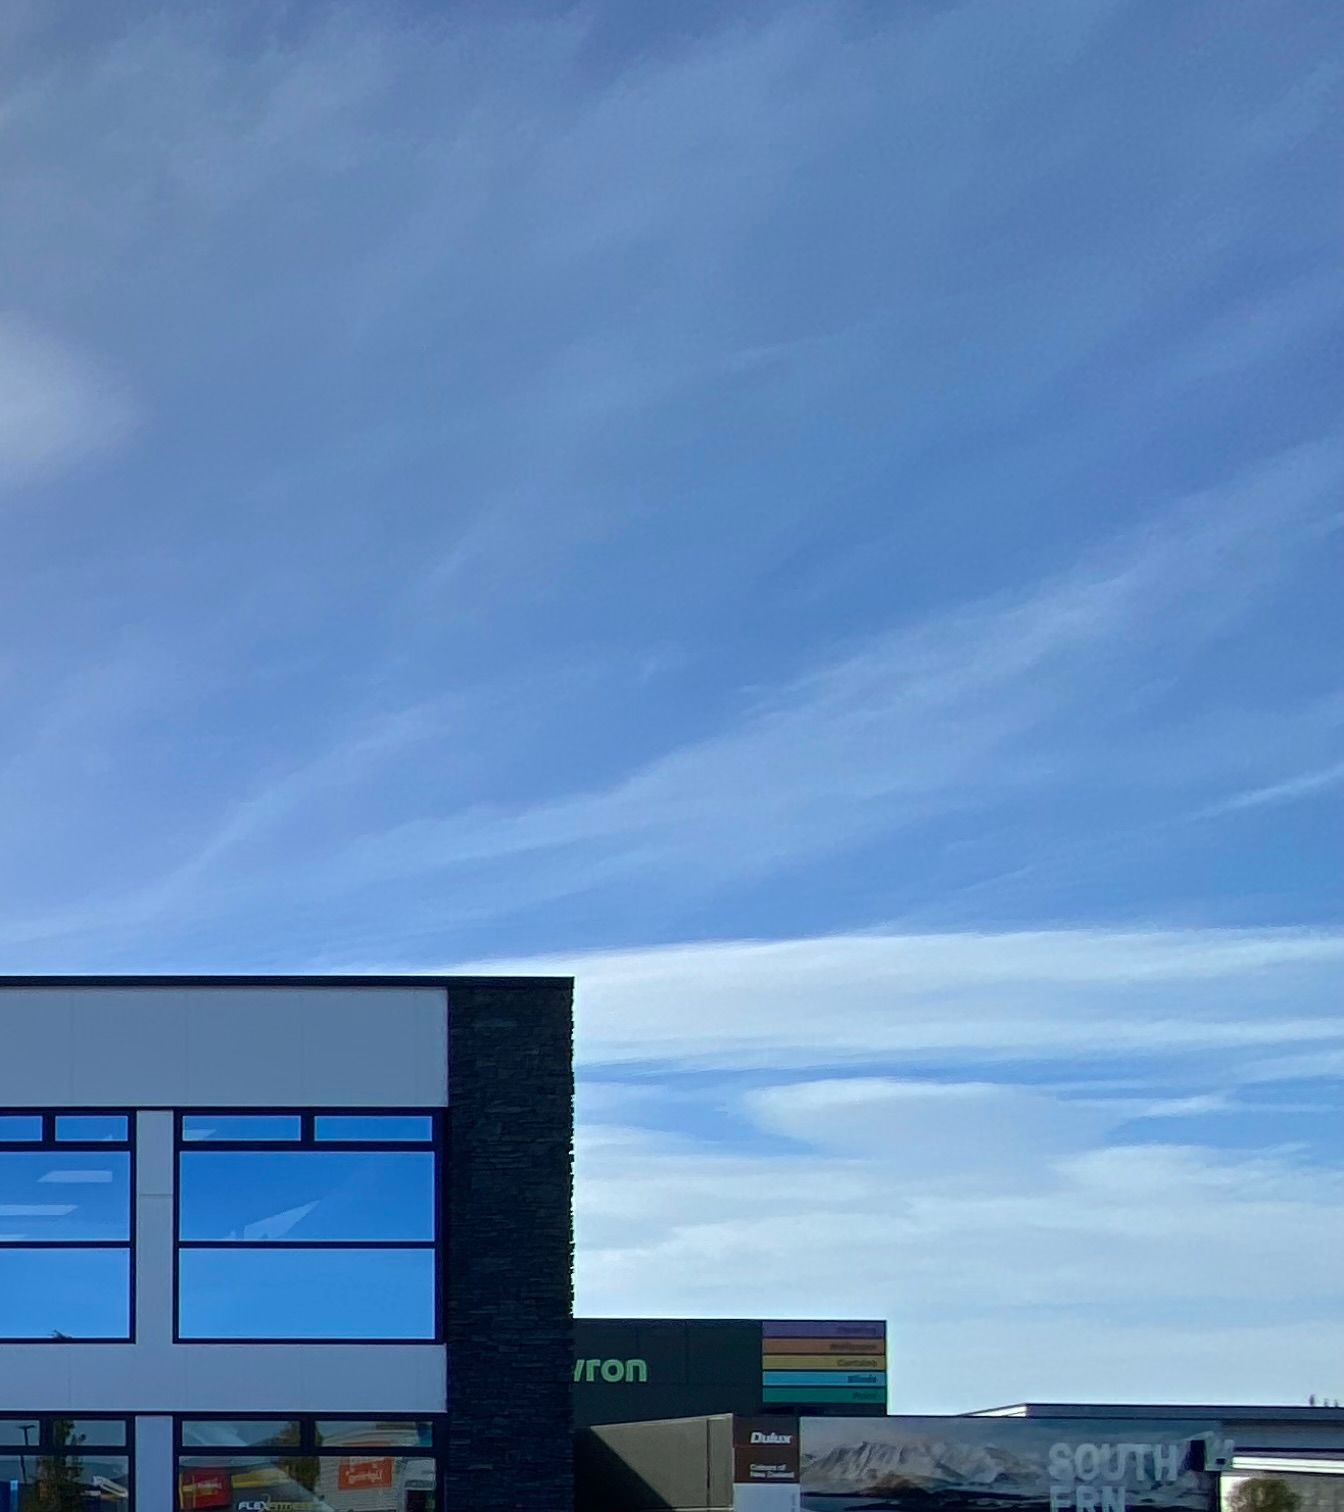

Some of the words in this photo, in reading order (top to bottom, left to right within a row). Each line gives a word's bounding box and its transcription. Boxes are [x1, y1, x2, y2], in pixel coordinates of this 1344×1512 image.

[574, 1358, 648, 1383] ron
[750, 1432, 792, 1444] Dulux
[1049, 1443, 1178, 1481] SOUTH
